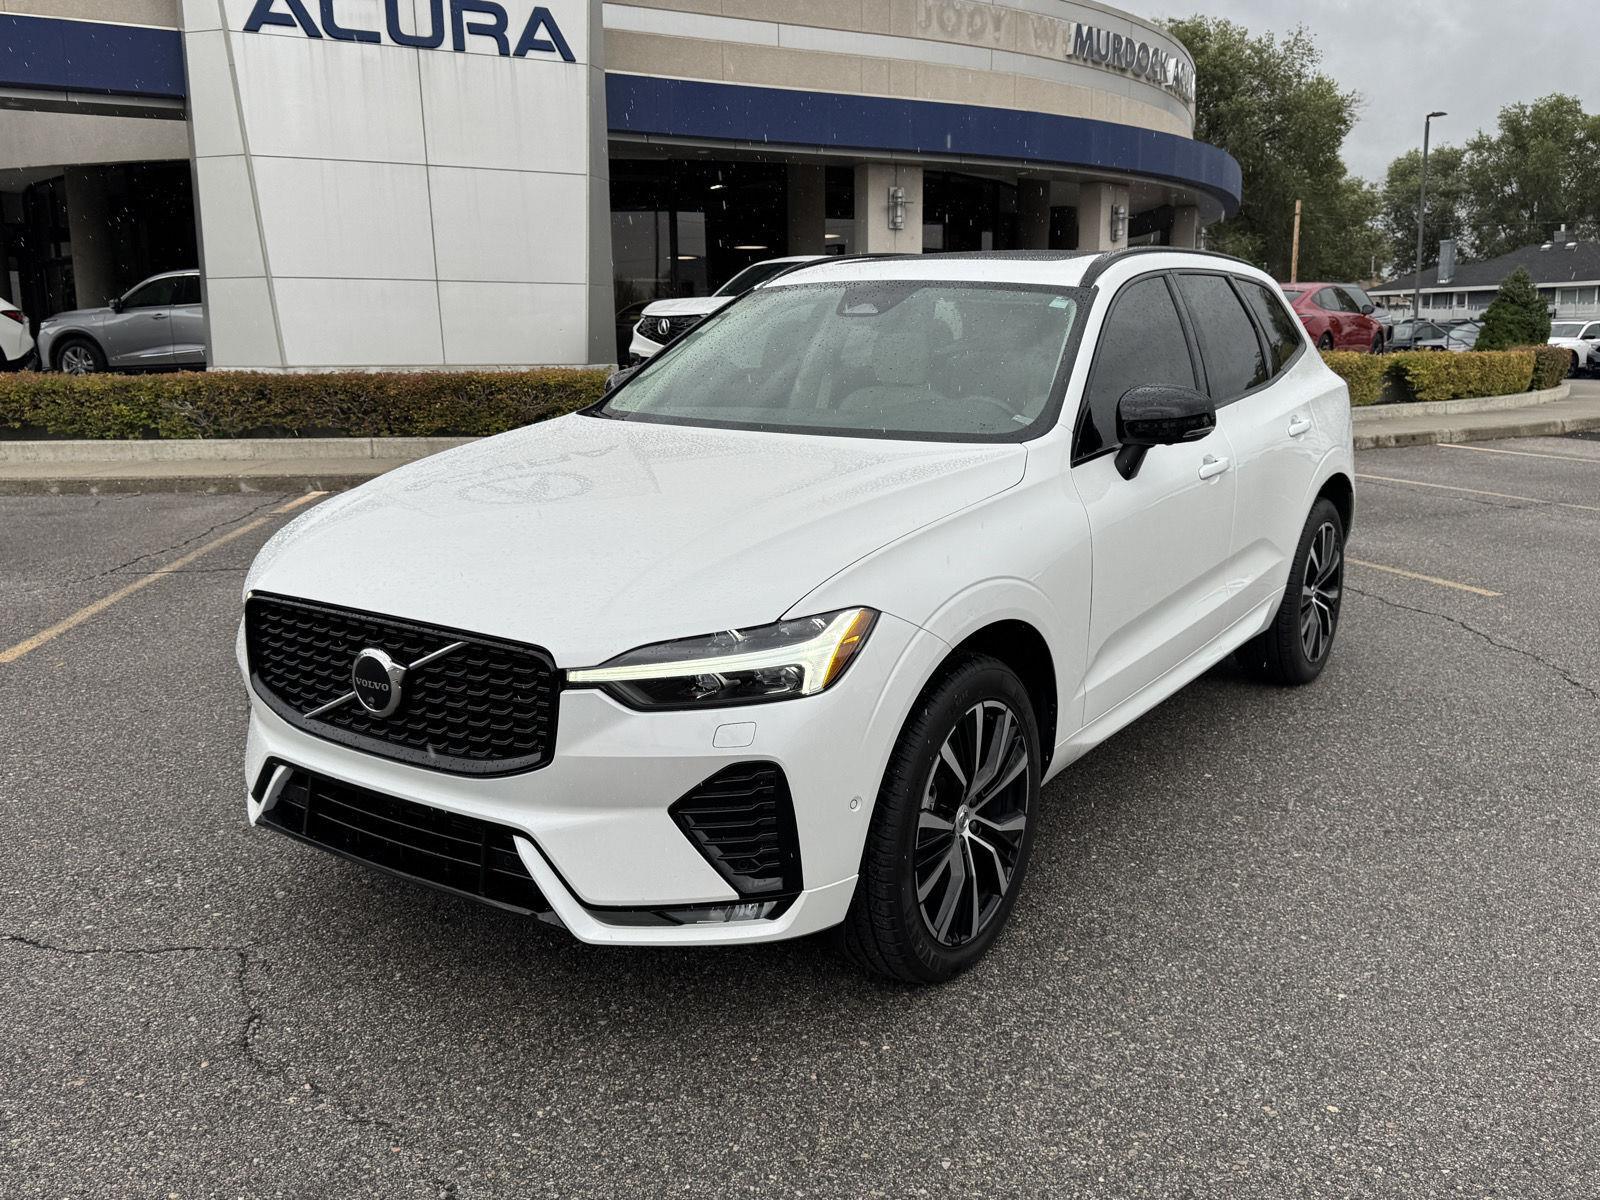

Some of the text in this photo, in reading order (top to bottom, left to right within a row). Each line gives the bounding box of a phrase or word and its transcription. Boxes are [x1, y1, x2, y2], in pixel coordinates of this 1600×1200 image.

[243, 0, 576, 62] ACURA
[1067, 22, 1169, 84] MURDOCK
[355, 677, 389, 691] VOLVO
